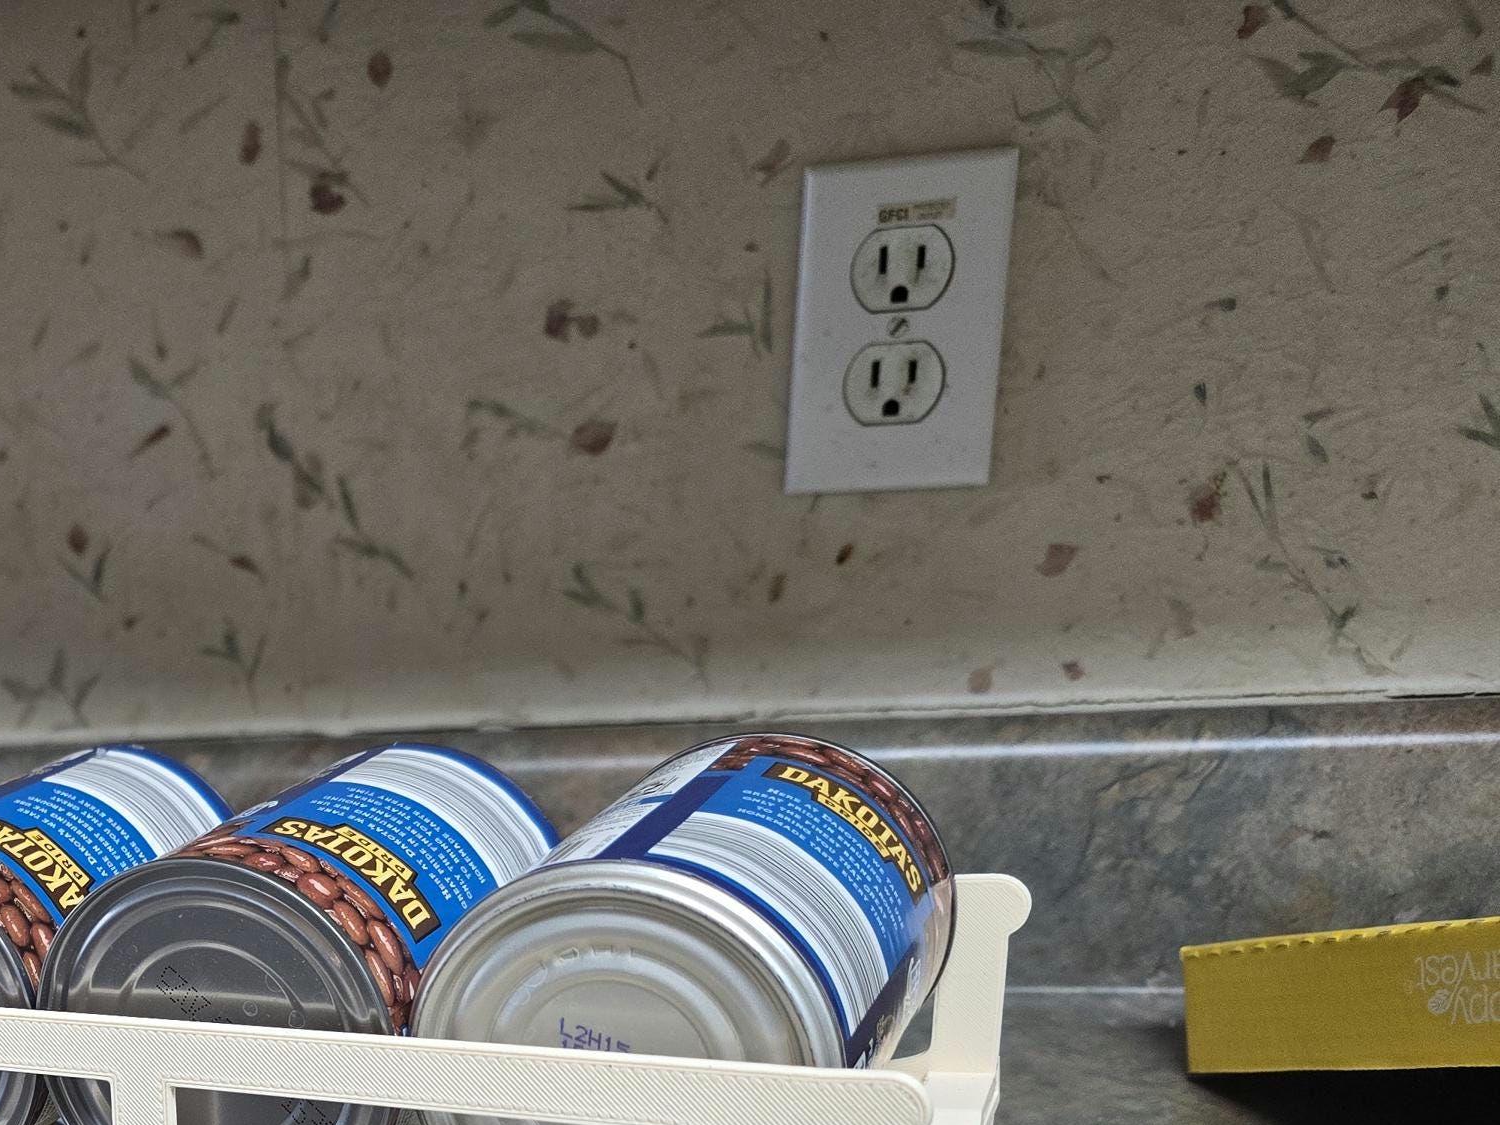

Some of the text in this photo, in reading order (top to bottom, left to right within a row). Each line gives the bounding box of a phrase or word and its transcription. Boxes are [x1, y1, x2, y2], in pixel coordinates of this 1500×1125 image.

[33, 805, 49, 814] WE
[50, 796, 79, 810] GREAT
[80, 798, 106, 818] EVERY
[80, 810, 102, 826] THAT
[334, 803, 352, 812] WE
[348, 814, 365, 824] WE
[376, 794, 409, 811] EVERY
[28, 796, 122, 862] FINEST BEANS AROUND
[50, 813, 93, 846] ENSURING
[103, 828, 122, 845] YOU
[106, 816, 130, 840] TASTE
[346, 793, 472, 880] TO BRING YOU THAT GREAT
[356, 810, 407, 839] ENSURING
[411, 810, 442, 832] TASTE
[778, 766, 922, 893] DAKOTA'S
[818, 793, 889, 858] PRIDE
[17, 807, 108, 877] AT DAKOTA'S WE TAKE
[92, 845, 104, 855] IN
[322, 795, 473, 900] ONLY THE FINEST BEANS AROUND
[341, 827, 408, 877] PRIDE
[366, 822, 416, 857] DAKOTA'S
[407, 838, 418, 849] IN
[736, 808, 806, 842] HOMEMADE
[809, 840, 839, 869] TASTE
[842, 870, 868, 902] EVERY
[742, 796, 776, 808] ONLY
[778, 806, 802, 818] THE
[804, 818, 841, 848] FINEST
[843, 850, 872, 883] BEANS
[742, 789, 782, 804] GREAT
[788, 801, 821, 823] PRIDE
[825, 822, 835, 832] IN
[838, 833, 882, 884] ENSURING
[884, 886, 895, 902] WE
[766, 788, 902, 905] HERE AT DAKOTA'S WE TAKE
[33, 834, 84, 881] PRIDE
[101, 856, 120, 876] RIDE
[416, 858, 428, 870] AT
[418, 846, 445, 876] PRIDE
[440, 830, 486, 884] HOMEMADE
[757, 806, 888, 920] TO BRING YOU THAT GREAT
[273, 820, 432, 930] DAKOTA'S
[428, 871, 452, 900] HERE
[444, 876, 469, 910] GREAT
